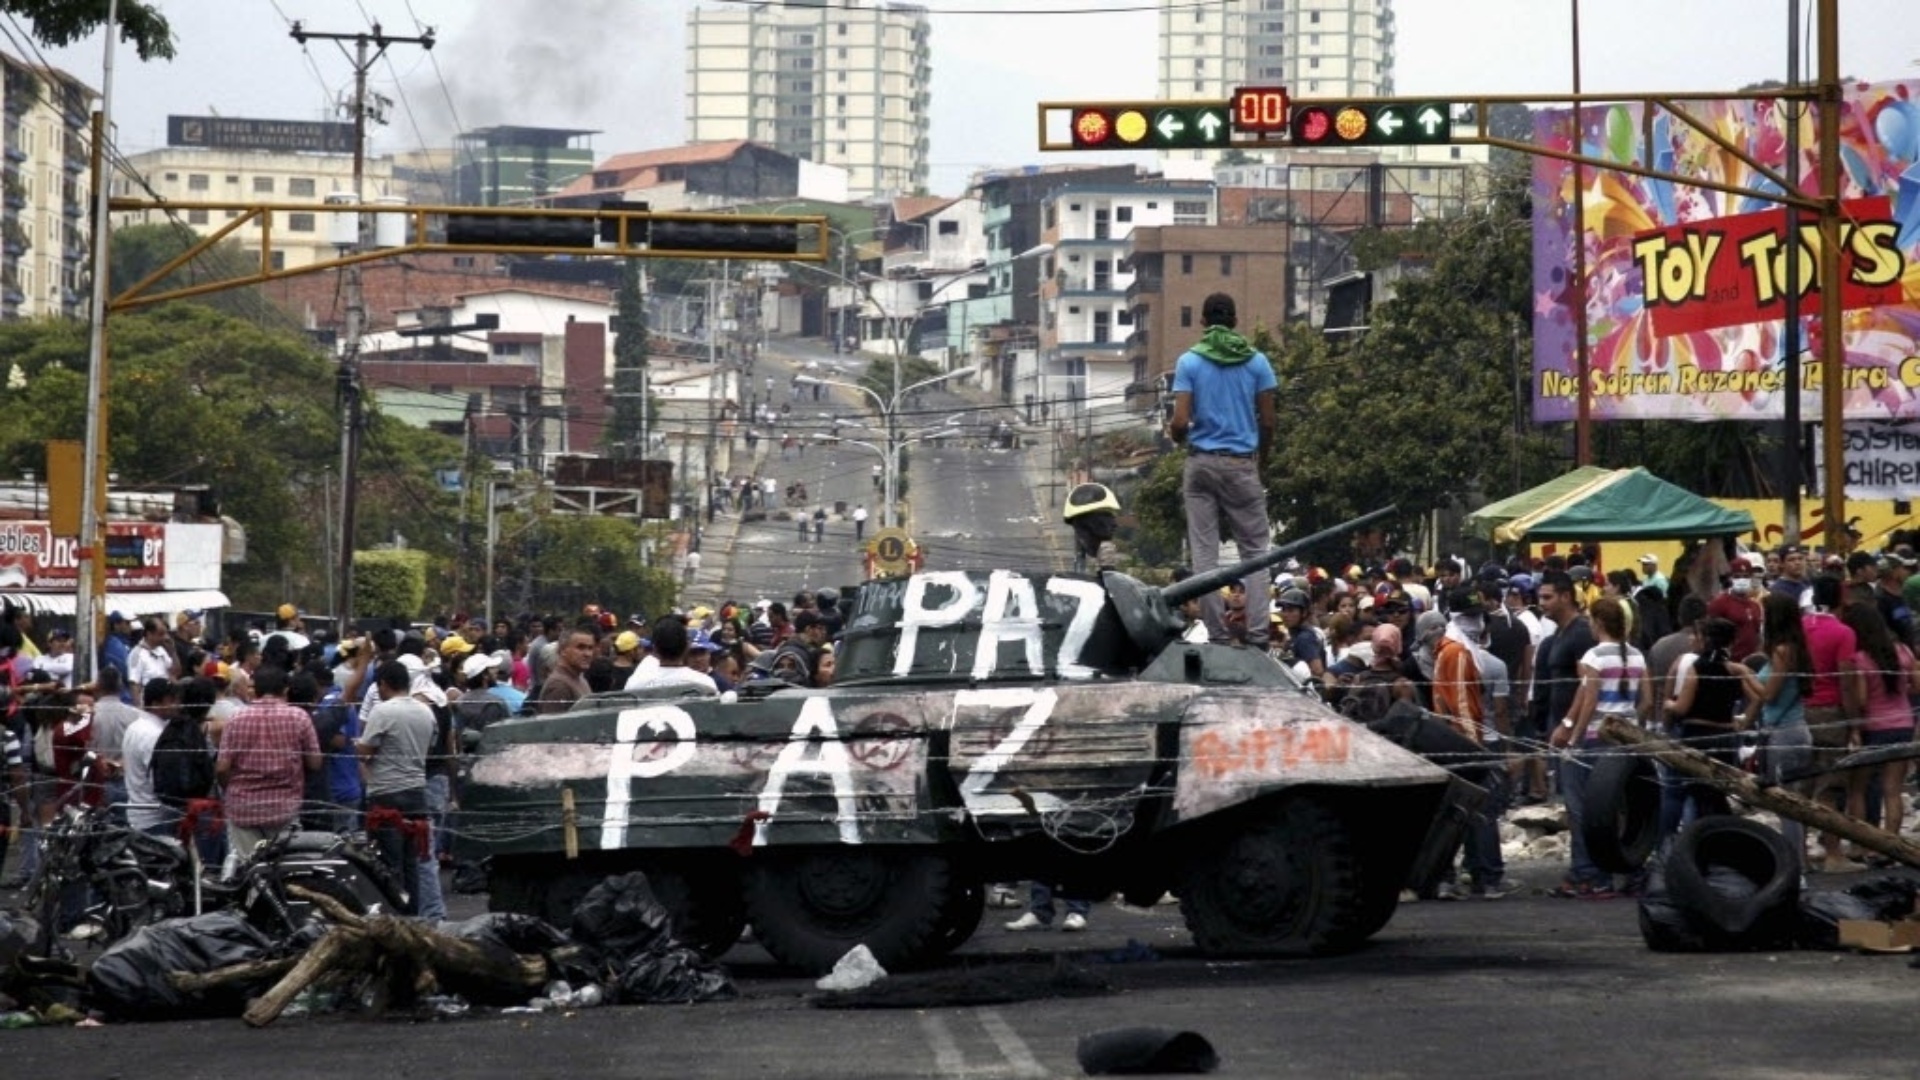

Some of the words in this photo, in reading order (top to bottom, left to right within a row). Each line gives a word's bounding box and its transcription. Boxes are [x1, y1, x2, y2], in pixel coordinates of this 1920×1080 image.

[1240, 93, 1282, 124] 00
[1632, 230, 1725, 309] TOY
[1590, 366, 1672, 397] Sobran
[1678, 362, 1787, 395] Razones
[1802, 360, 1889, 391] Pra
[893, 569, 1105, 680] PAZ
